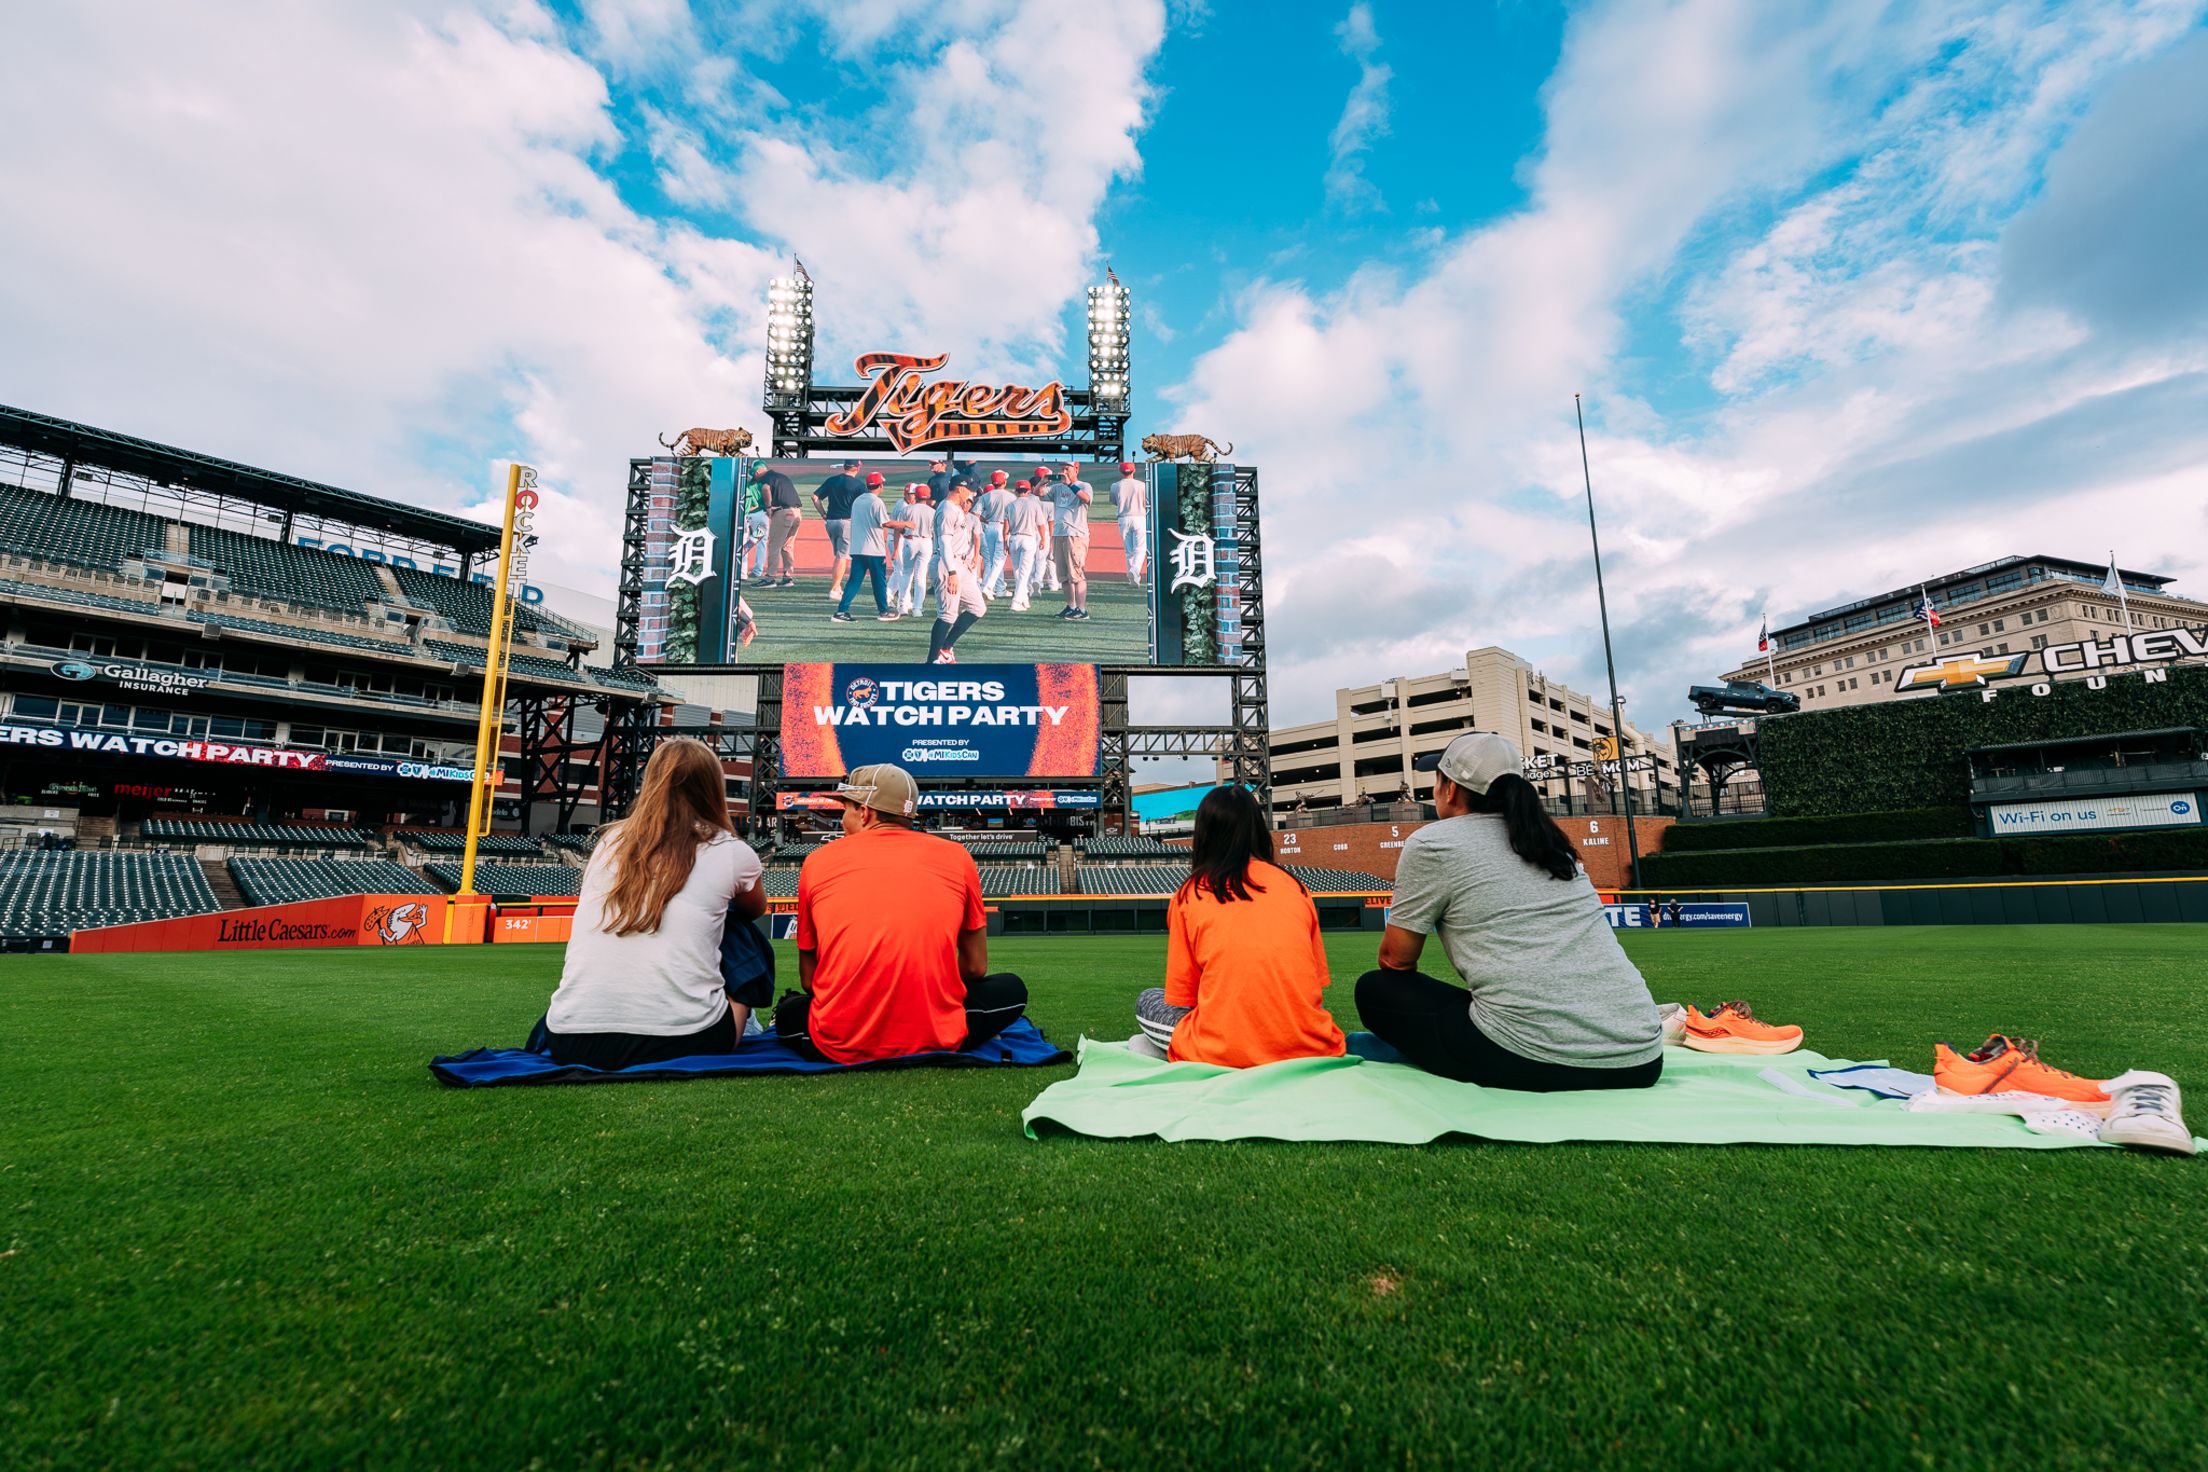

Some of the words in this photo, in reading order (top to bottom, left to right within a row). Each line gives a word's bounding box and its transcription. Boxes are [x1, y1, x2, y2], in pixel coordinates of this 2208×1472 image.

[825, 352, 1072, 456] Tigers
[508, 466, 539, 600] ROCKET
[103, 665, 208, 688] Gallagher
[119, 681, 189, 696] INSURANCE
[879, 681, 1005, 702] TIGERS
[813, 706, 945, 726] WATCH
[948, 706, 1069, 726] PARTY
[70, 731, 202, 758] WATCH
[206, 744, 318, 768] PARTY
[325, 759, 380, 770] PRESENTED
[381, 764, 394, 772] BY
[1520, 754, 1558, 769] KET
[1527, 770, 1550, 781] age
[114, 783, 173, 800] meijer
[970, 795, 1026, 805] PARTY
[1999, 810, 2045, 824] Wi-Fi
[2050, 812, 2072, 822] on
[2077, 810, 2097, 820] us
[1391, 826, 1399, 837] 5
[1589, 820, 1599, 833] 6
[949, 833, 980, 841] Together
[1283, 834, 1297, 845] 23
[1582, 837, 1609, 846] KALINE
[217, 918, 266, 942] Little
